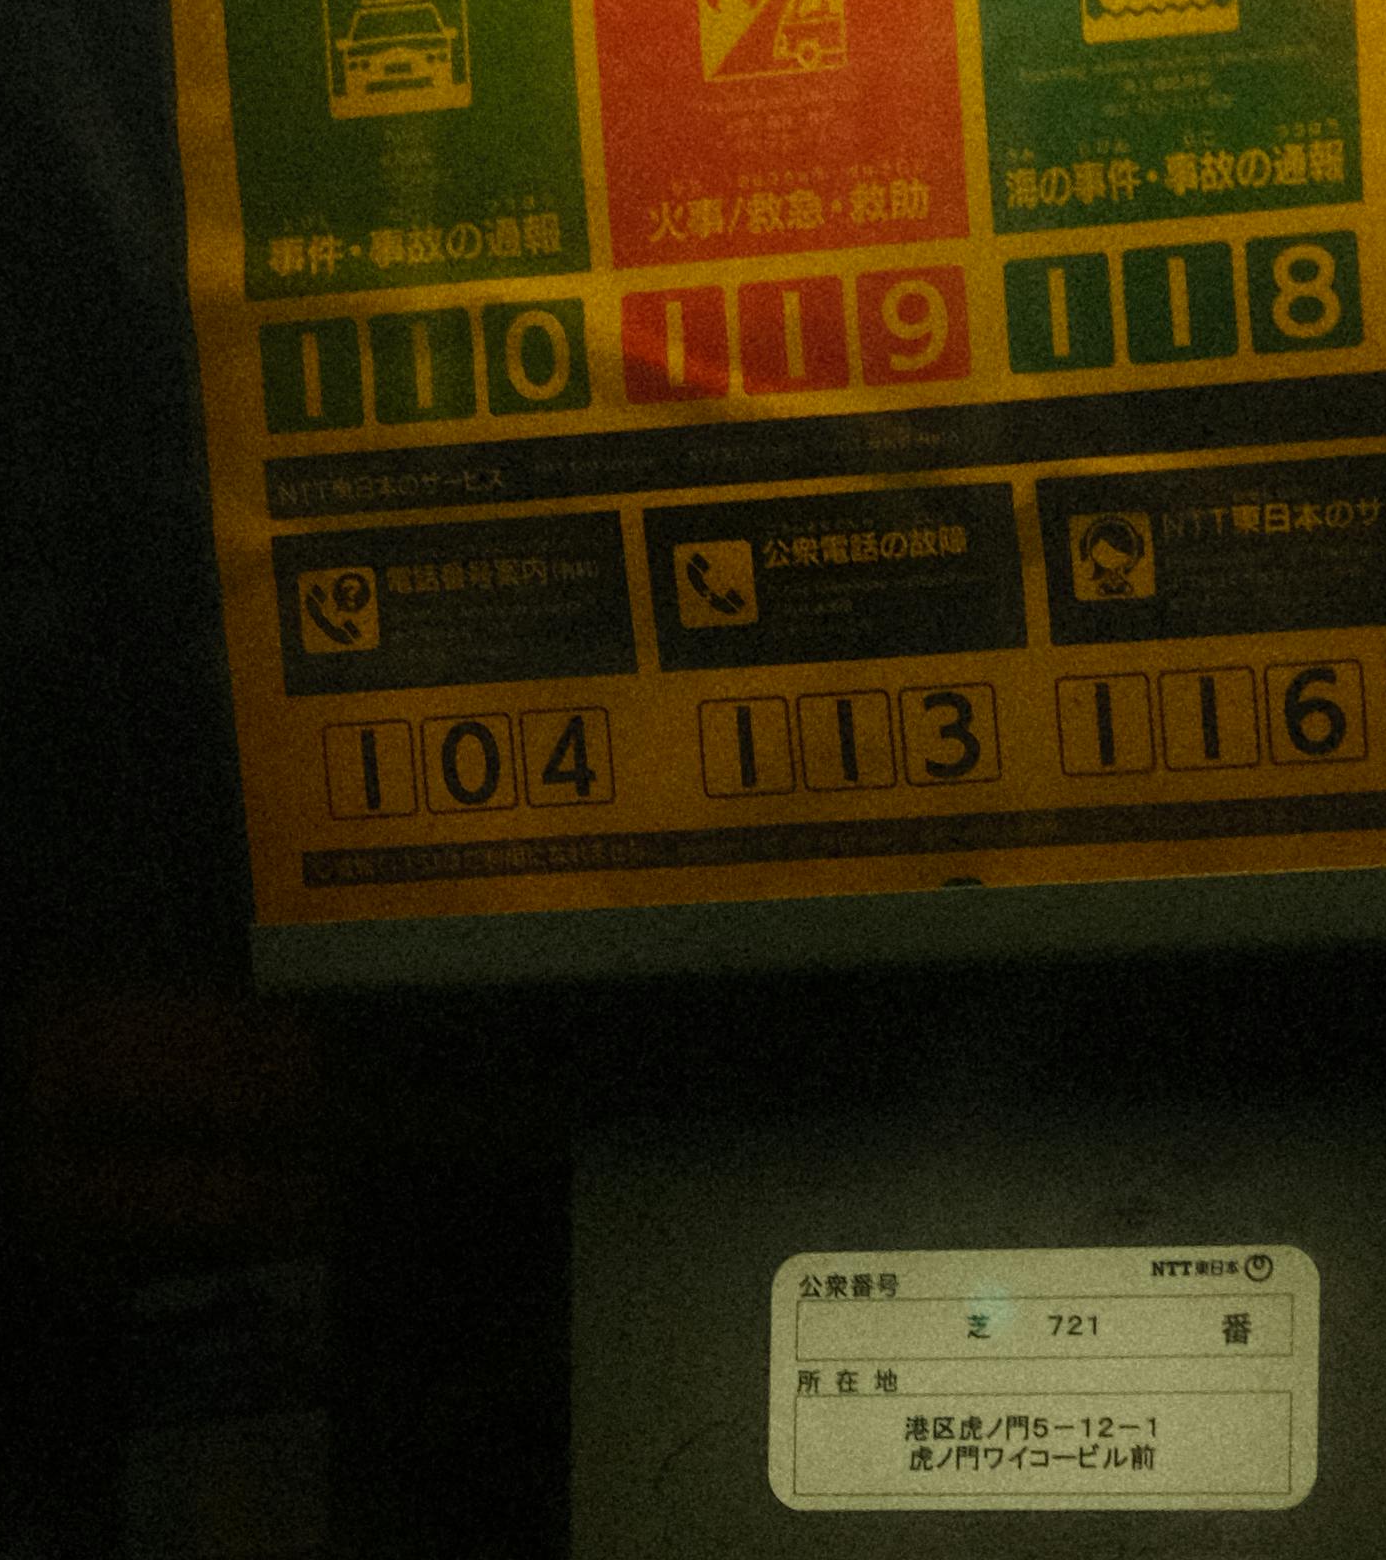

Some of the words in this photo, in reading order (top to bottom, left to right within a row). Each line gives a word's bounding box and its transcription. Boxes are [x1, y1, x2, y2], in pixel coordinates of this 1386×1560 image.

[1005, 139, 1346, 210] 海の事件・事故の通報
[268, 213, 563, 277] 事件・事故の通報
[648, 177, 932, 244] 火事/救急・救助
[663, 277, 950, 388] 119
[1047, 243, 1344, 359] 118
[301, 309, 571, 420] 110
[763, 525, 969, 570] 公衆電話の故障
[736, 690, 981, 788] 113
[1095, 666, 1346, 766] 116
[361, 715, 596, 810] 104
[798, 1271, 901, 1298] 公衆番号
[1047, 1313, 1101, 1338] 721
[1221, 1309, 1253, 1347] 番
[908, 1444, 1157, 1472] 虎ノ門ワイコービル前
